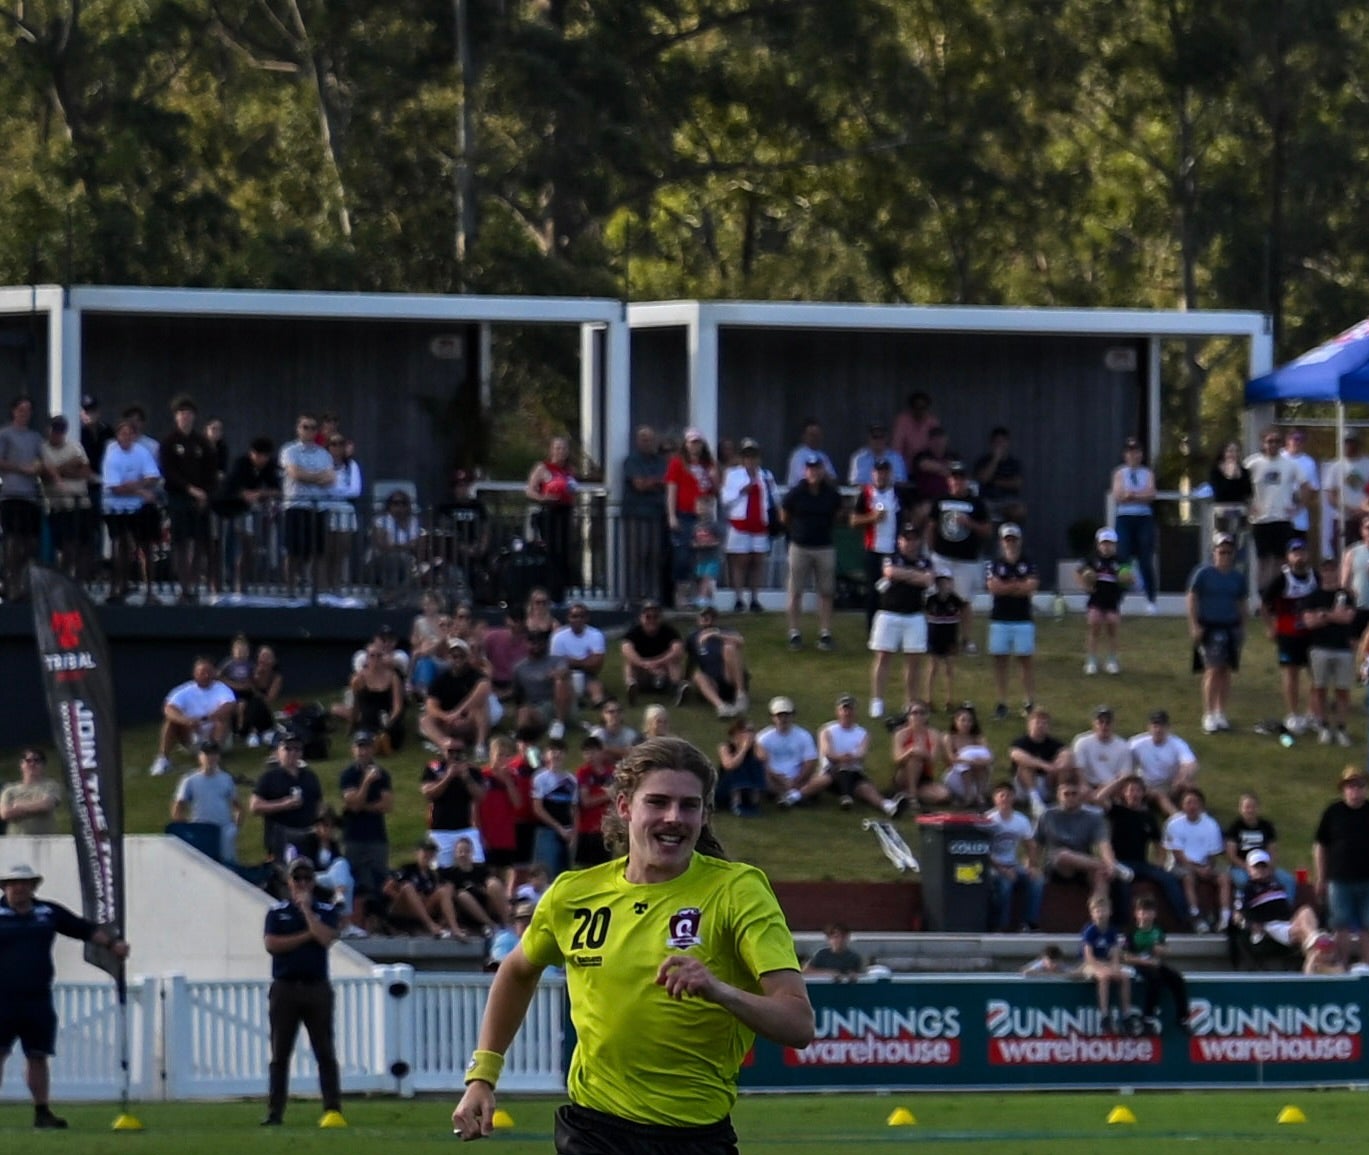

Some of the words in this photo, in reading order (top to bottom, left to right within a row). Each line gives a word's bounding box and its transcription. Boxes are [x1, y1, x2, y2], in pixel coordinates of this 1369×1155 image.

[44, 652, 96, 672] TRIBAL
[75, 700, 98, 769] JOIN
[571, 906, 612, 950] 20
[814, 1007, 961, 1038] UNNINGS
[986, 998, 1163, 1038] BUNNI
[1186, 998, 1362, 1036] BUNNINGS
[795, 1031, 950, 1064] warehouse
[999, 1031, 1153, 1062] warehouse
[1200, 1030, 1353, 1061] warehouse
